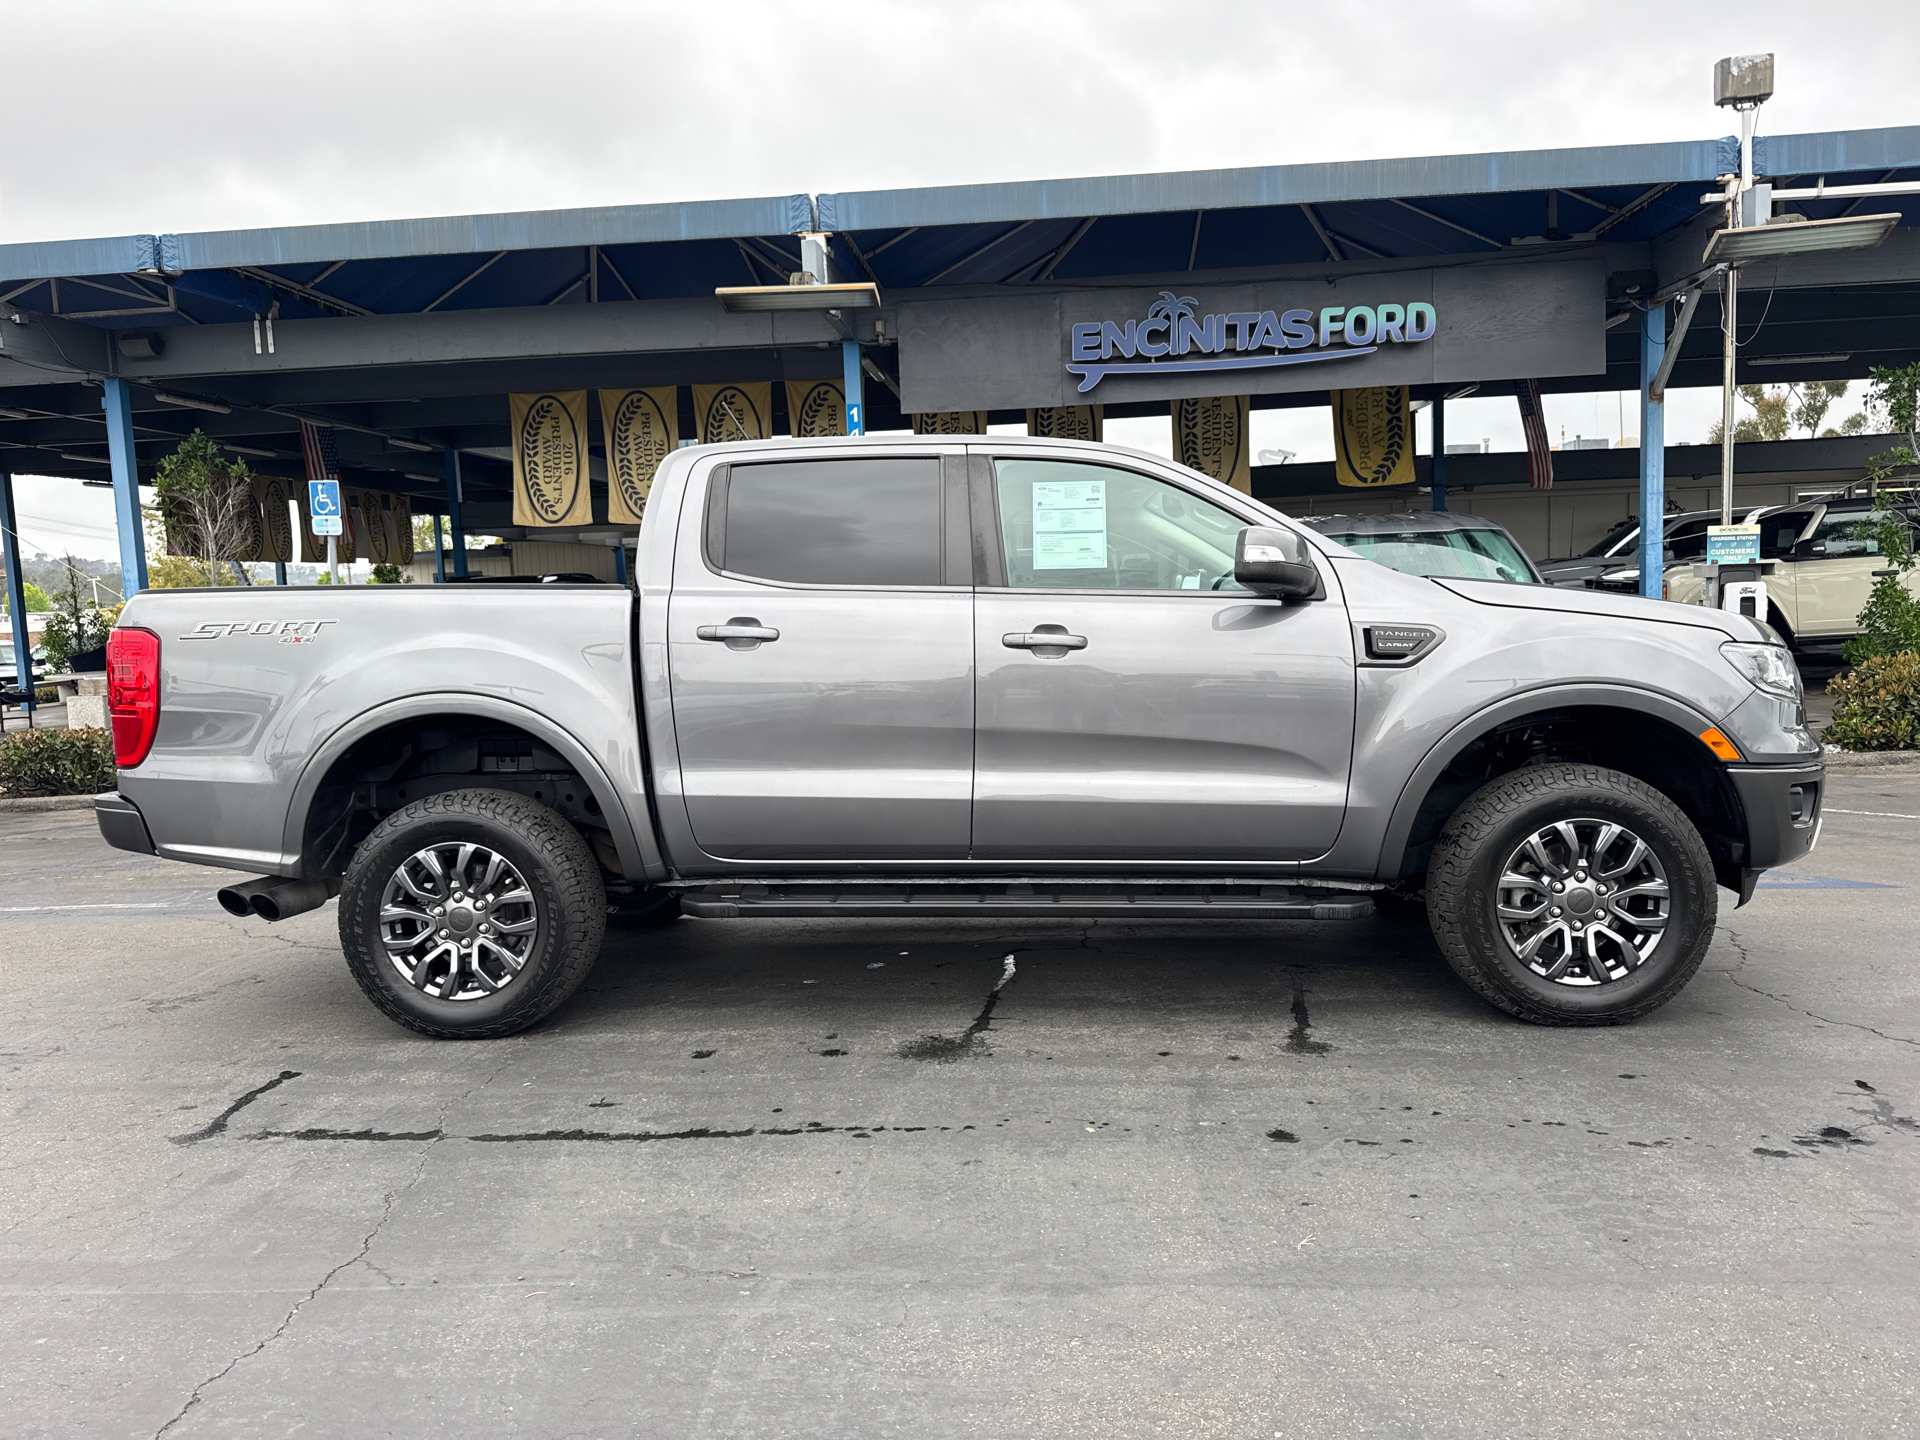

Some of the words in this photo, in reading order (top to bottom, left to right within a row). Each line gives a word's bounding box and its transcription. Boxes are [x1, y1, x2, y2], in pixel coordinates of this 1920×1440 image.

[1071, 291, 1315, 362] ENCINITAS
[1319, 302, 1437, 348] FORD
[1202, 406, 1212, 457] AWARD
[1212, 397, 1222, 478] RESIDENT'S
[1223, 412, 1235, 447] 2022
[1346, 408, 1354, 427] 2025
[1356, 388, 1373, 471] PRESIDEN
[542, 437, 552, 485] AWARD
[550, 416, 563, 505] PRESIDENT'S
[562, 442, 573, 476] 2016
[632, 432, 646, 482] AWARD
[641, 412, 655, 489] PRESIDEN
[1739, 586, 1757, 594] Ford
[177, 619, 340, 641] SPORT
[1375, 630, 1430, 638] RANGER
